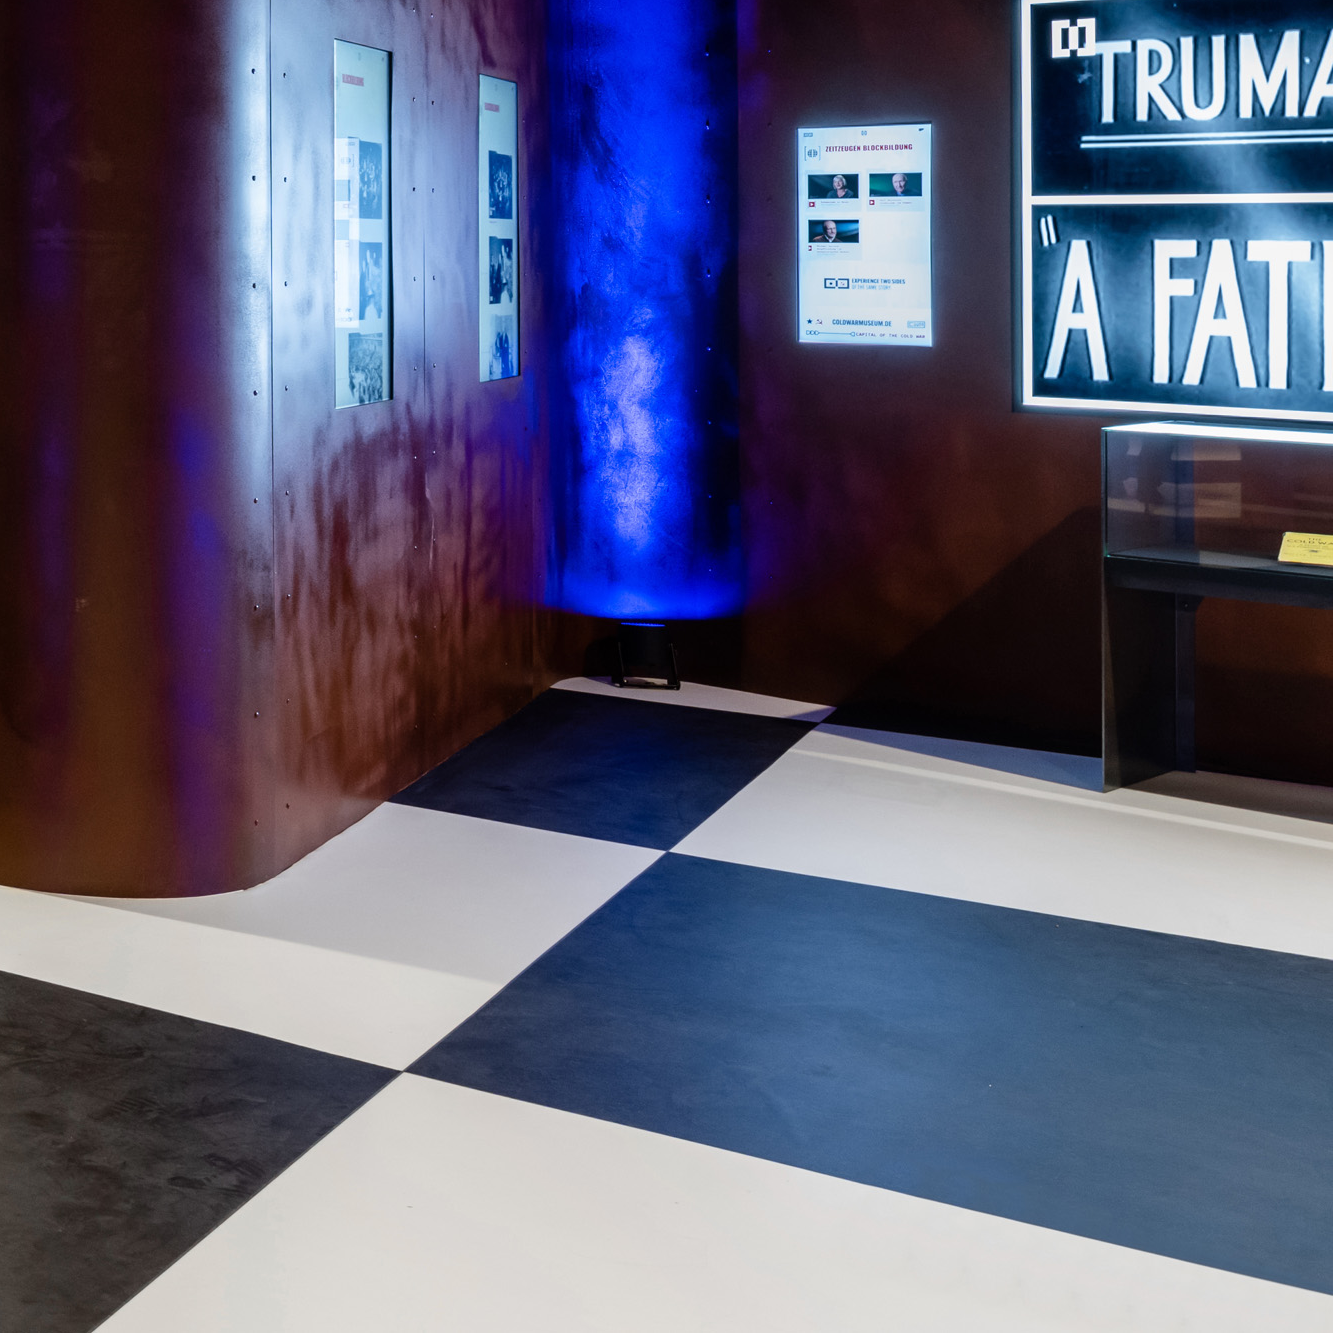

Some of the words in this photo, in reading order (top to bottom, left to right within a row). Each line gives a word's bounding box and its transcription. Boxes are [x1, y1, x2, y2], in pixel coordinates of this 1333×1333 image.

[825, 145, 861, 153] ZEITZEUGEN
[862, 143, 913, 152] BLOCKBILDUNG
[1152, 238, 1333, 392] FAT
[832, 319, 892, 327] COLDWARMUSEUM.DE
